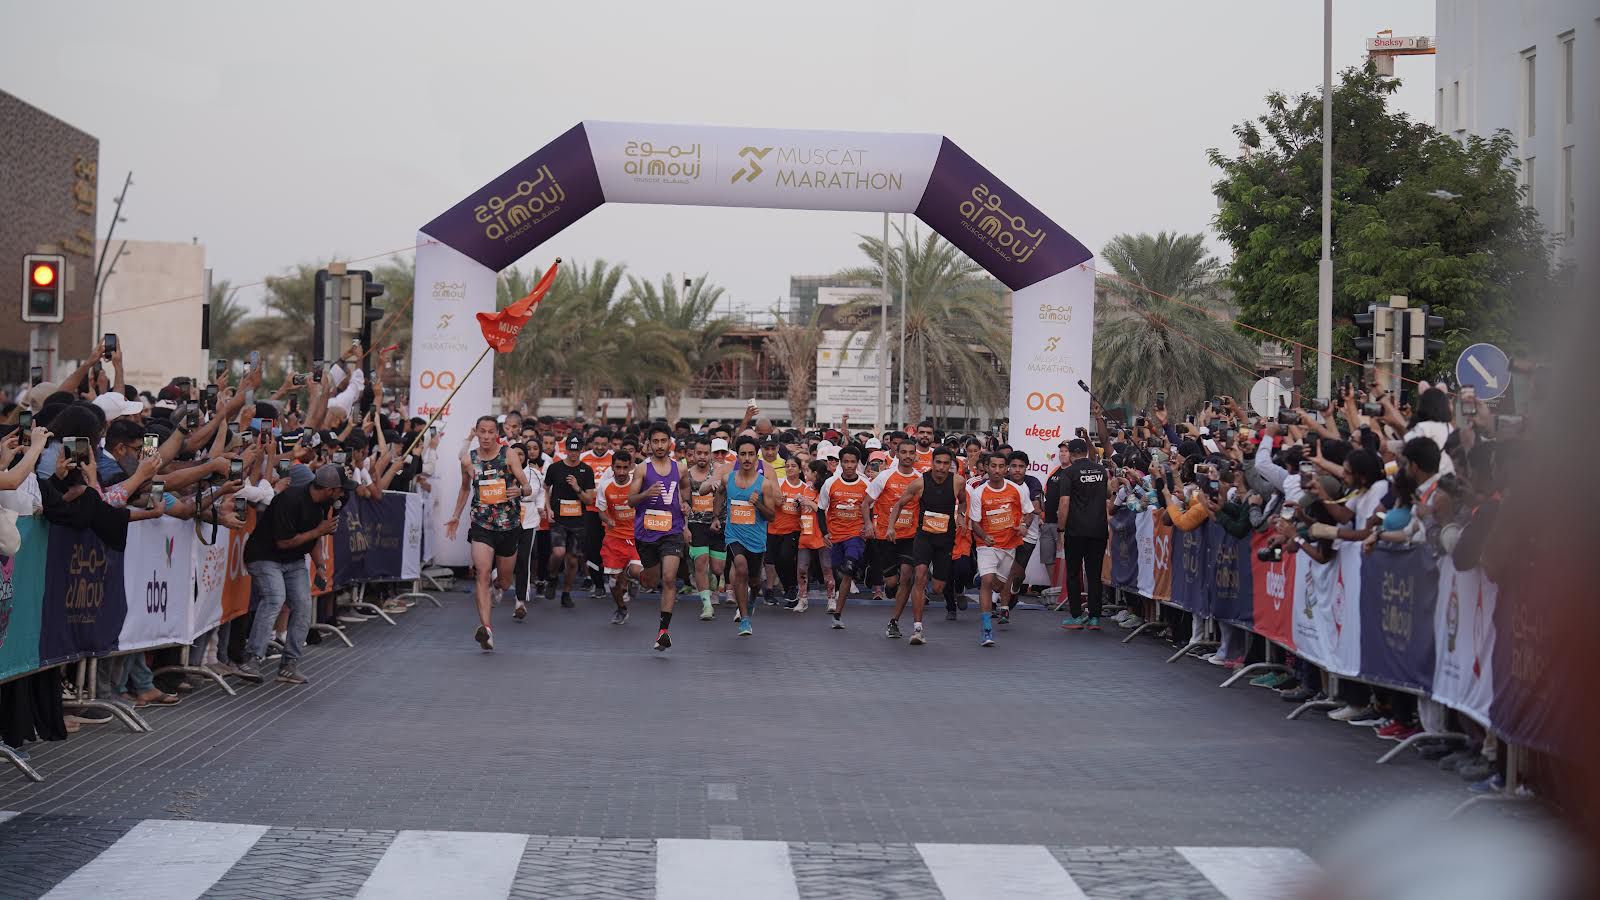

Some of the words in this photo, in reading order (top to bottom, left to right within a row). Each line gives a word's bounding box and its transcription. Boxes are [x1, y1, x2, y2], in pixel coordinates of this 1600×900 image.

[1374, 39, 1404, 48] Shaksy
[776, 147, 869, 166] MUSCAT
[775, 169, 903, 191] MARATHON
[499, 320, 520, 335] MUS
[1027, 362, 1075, 375] MARATHON
[419, 370, 456, 391] OQ
[1026, 391, 1065, 413] OQ
[1025, 424, 1061, 438] akeed
[1080, 474, 1103, 483] CREW
[647, 519, 670, 527] 51347
[146, 569, 168, 622] abq
